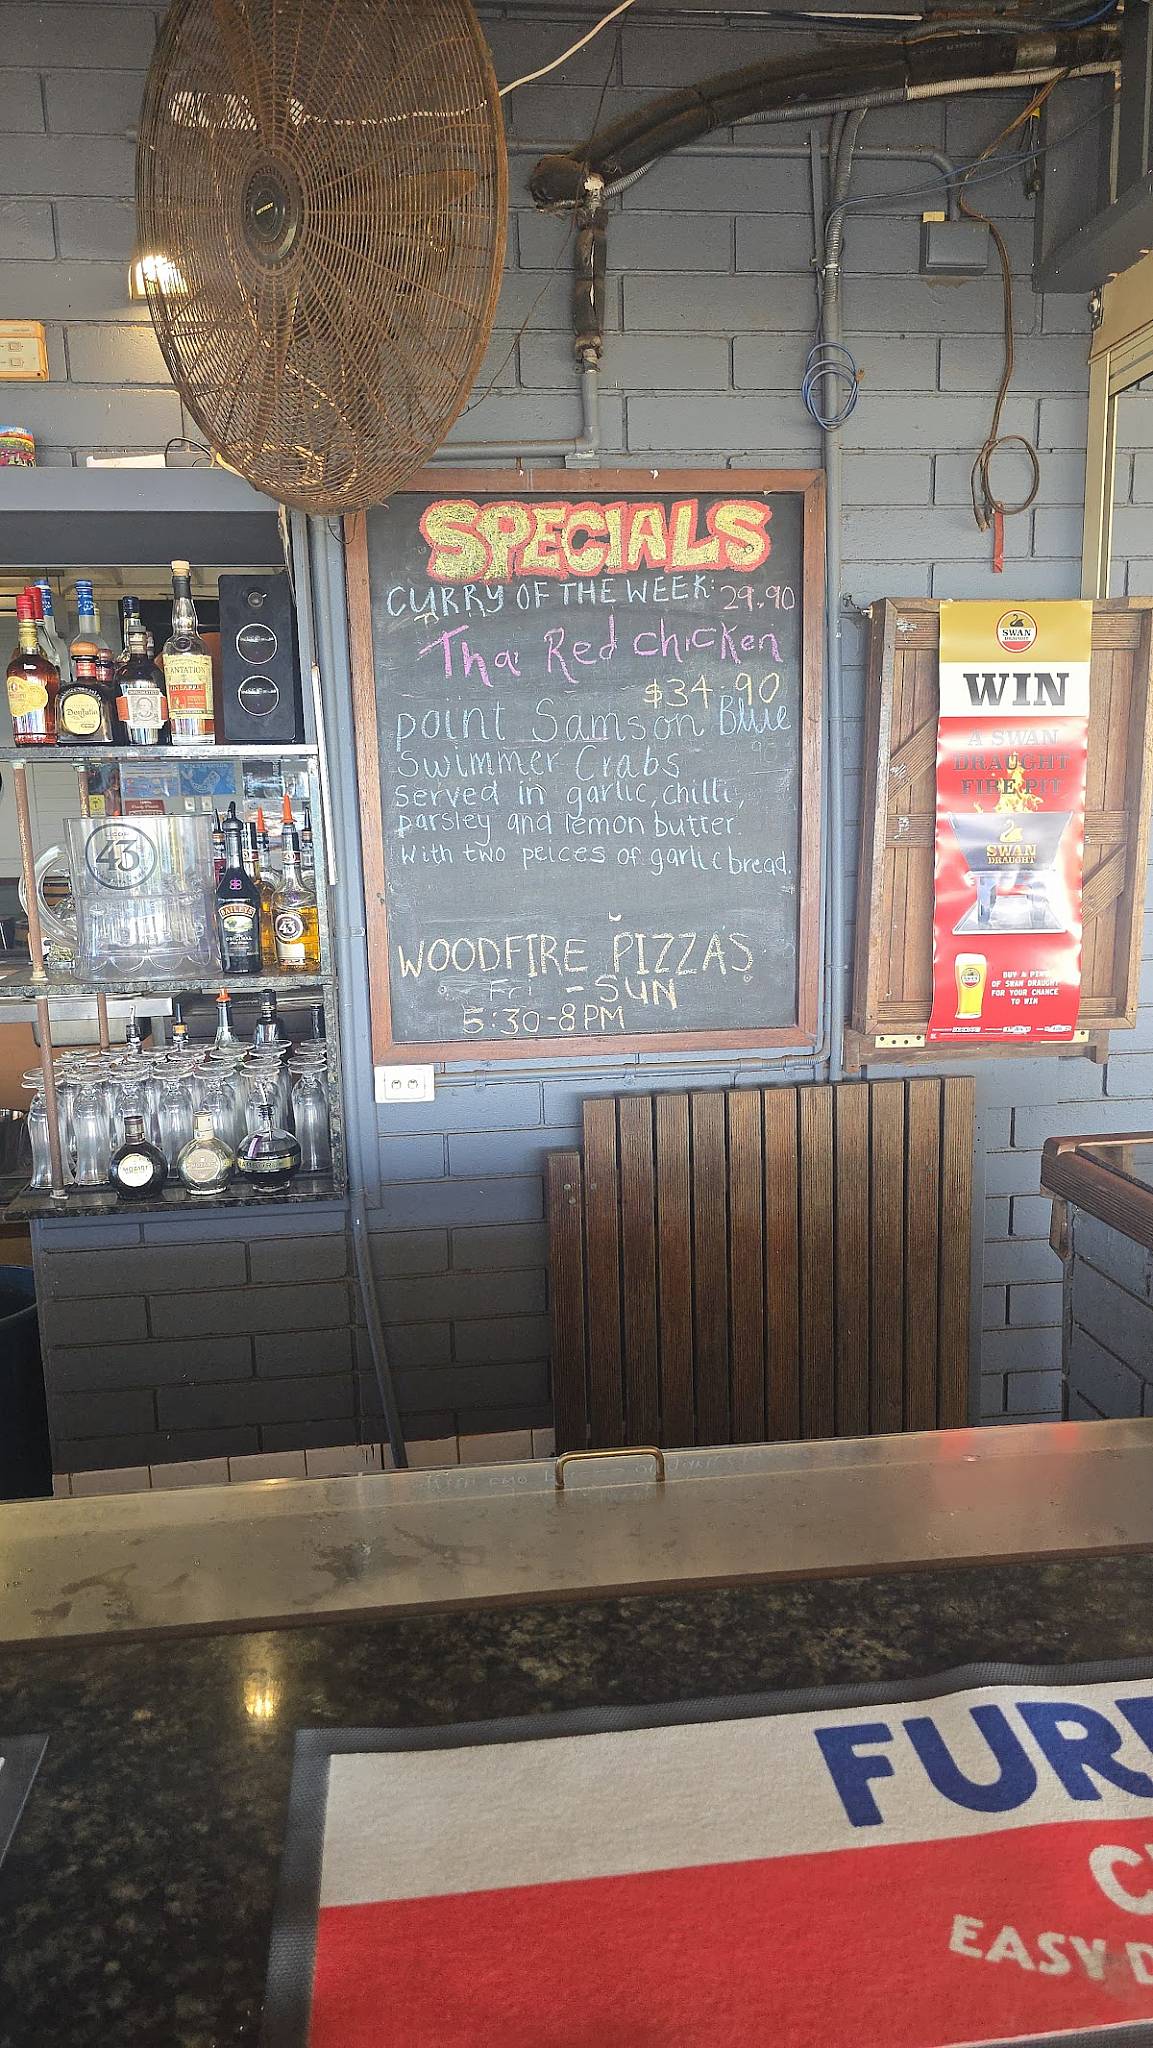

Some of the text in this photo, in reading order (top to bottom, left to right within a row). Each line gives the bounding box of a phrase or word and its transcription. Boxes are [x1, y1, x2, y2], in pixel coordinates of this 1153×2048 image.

[419, 498, 773, 584] SPECIALS
[387, 575, 797, 616] CURRY OF THE WEEK: 29.90
[543, 612, 619, 684] Red
[643, 671, 781, 709] $34.90
[963, 672, 1070, 706] WIN
[531, 698, 704, 742] Samson
[719, 694, 792, 736] Blue
[967, 729, 1059, 746] A SWAN
[576, 744, 681, 782] Crabs
[953, 754, 1070, 771] DRAUGHT
[395, 780, 498, 809] served
[518, 779, 547, 806] in
[961, 778, 1062, 796] FIRE PIT
[394, 811, 492, 846] parsley
[507, 811, 552, 834] and
[564, 812, 645, 836] lemon
[96, 839, 140, 871] 43
[463, 845, 507, 863] two
[521, 844, 606, 870] peices
[617, 845, 639, 867] of
[649, 844, 722, 877] garlic
[728, 849, 792, 877] bread.
[986, 844, 1037, 857] SWAN
[988, 856, 1036, 864] DRAUGHT
[221, 905, 255, 916] BAILEYS
[279, 920, 296, 934] 43
[397, 931, 755, 979] WOODFIRE PIZZAS
[488, 978, 535, 1002] Fri
[594, 974, 679, 1010] SUN
[948, 1914, 1106, 1981] EASY
